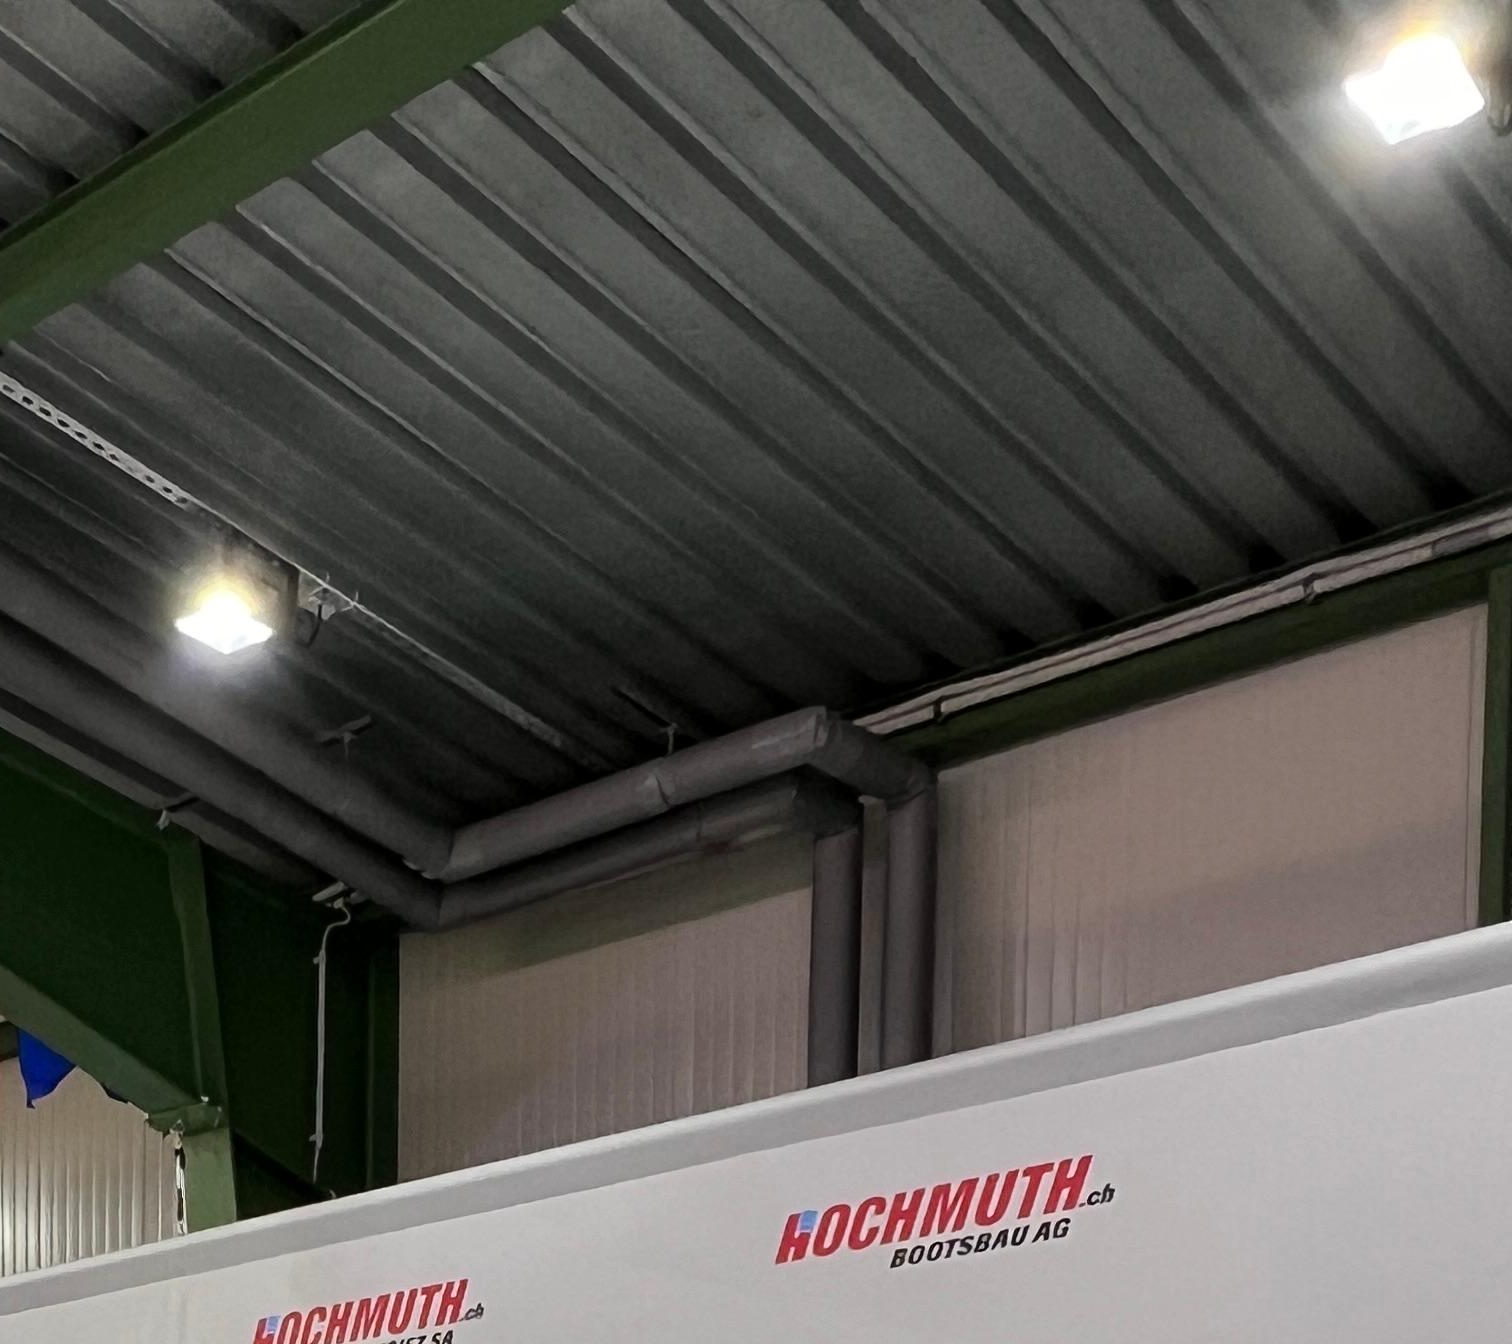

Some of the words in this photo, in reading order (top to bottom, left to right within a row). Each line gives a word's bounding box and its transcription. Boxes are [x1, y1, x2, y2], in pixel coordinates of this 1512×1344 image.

[775, 1155, 1115, 1265] HOCHMUTH.ch
[890, 1225, 1029, 1268] BOOTSBAU
[1032, 1217, 1071, 1244] AG
